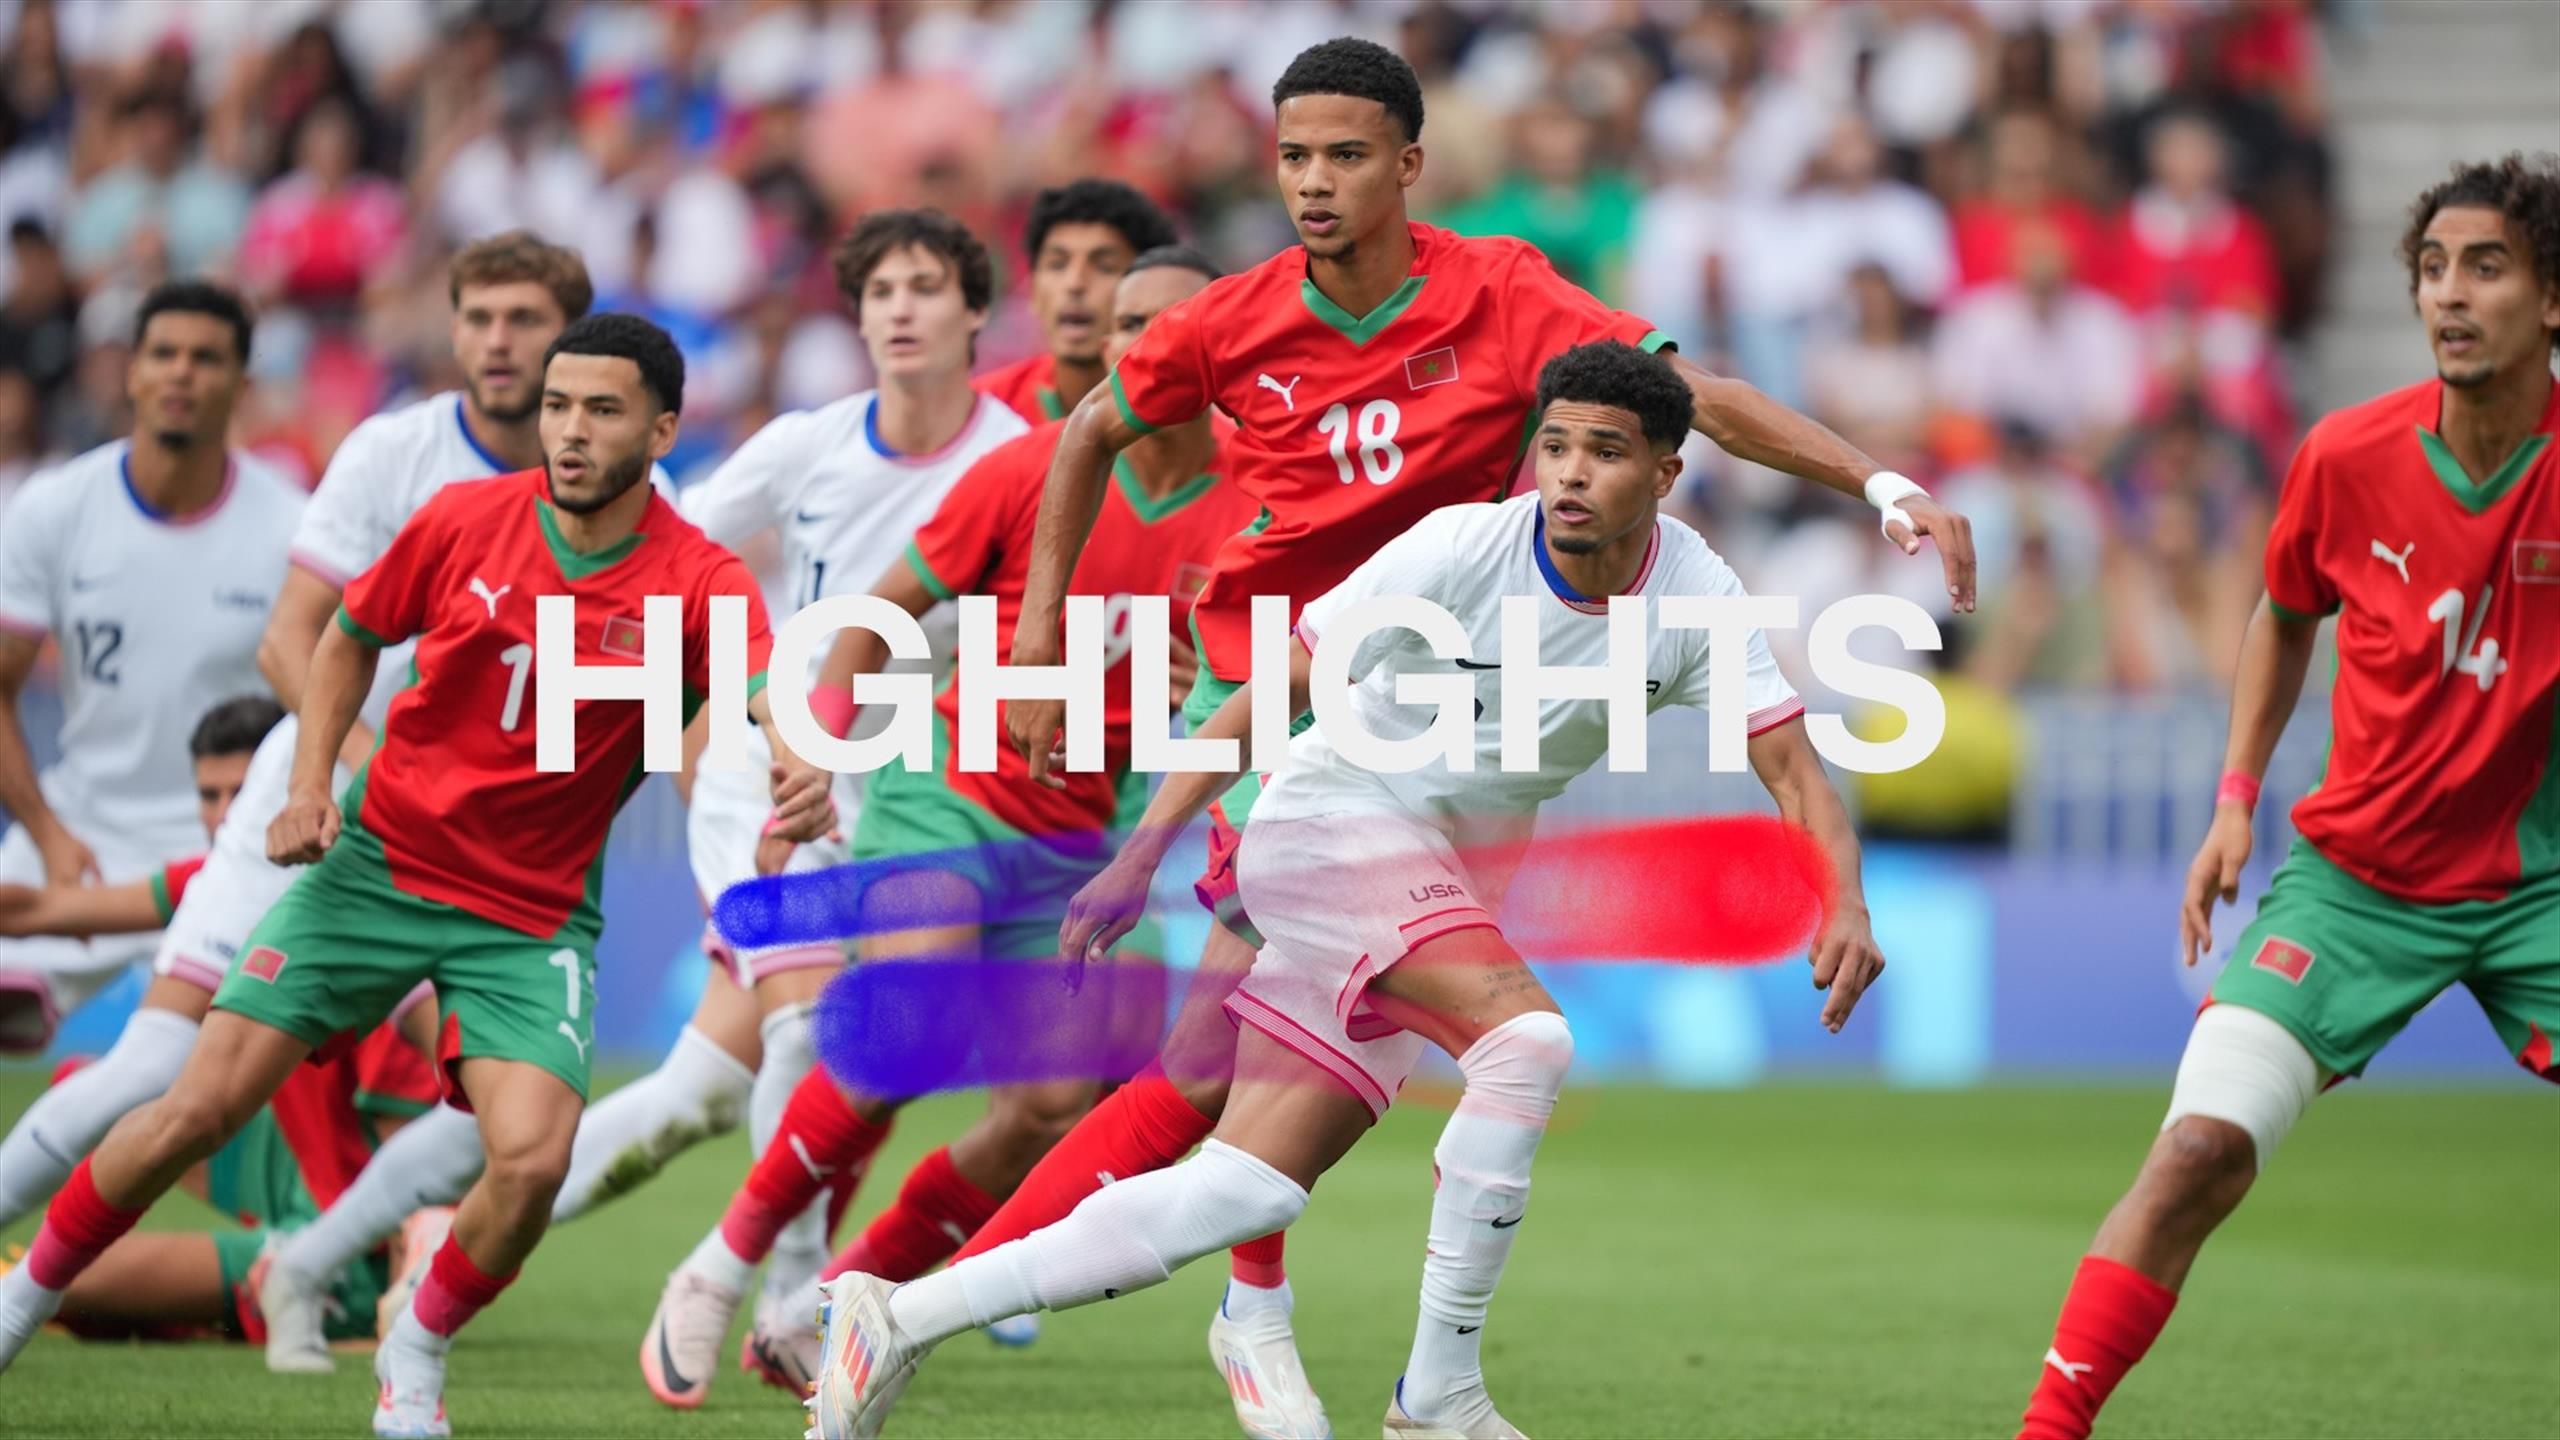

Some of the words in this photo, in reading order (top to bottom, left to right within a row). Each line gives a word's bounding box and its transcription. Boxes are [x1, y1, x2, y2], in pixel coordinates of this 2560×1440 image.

[1317, 399, 1404, 486] 18
[76, 619, 122, 684] 12
[2427, 583, 2508, 692] 14
[1409, 884, 1465, 903] USA
[548, 948, 595, 1019] 1
